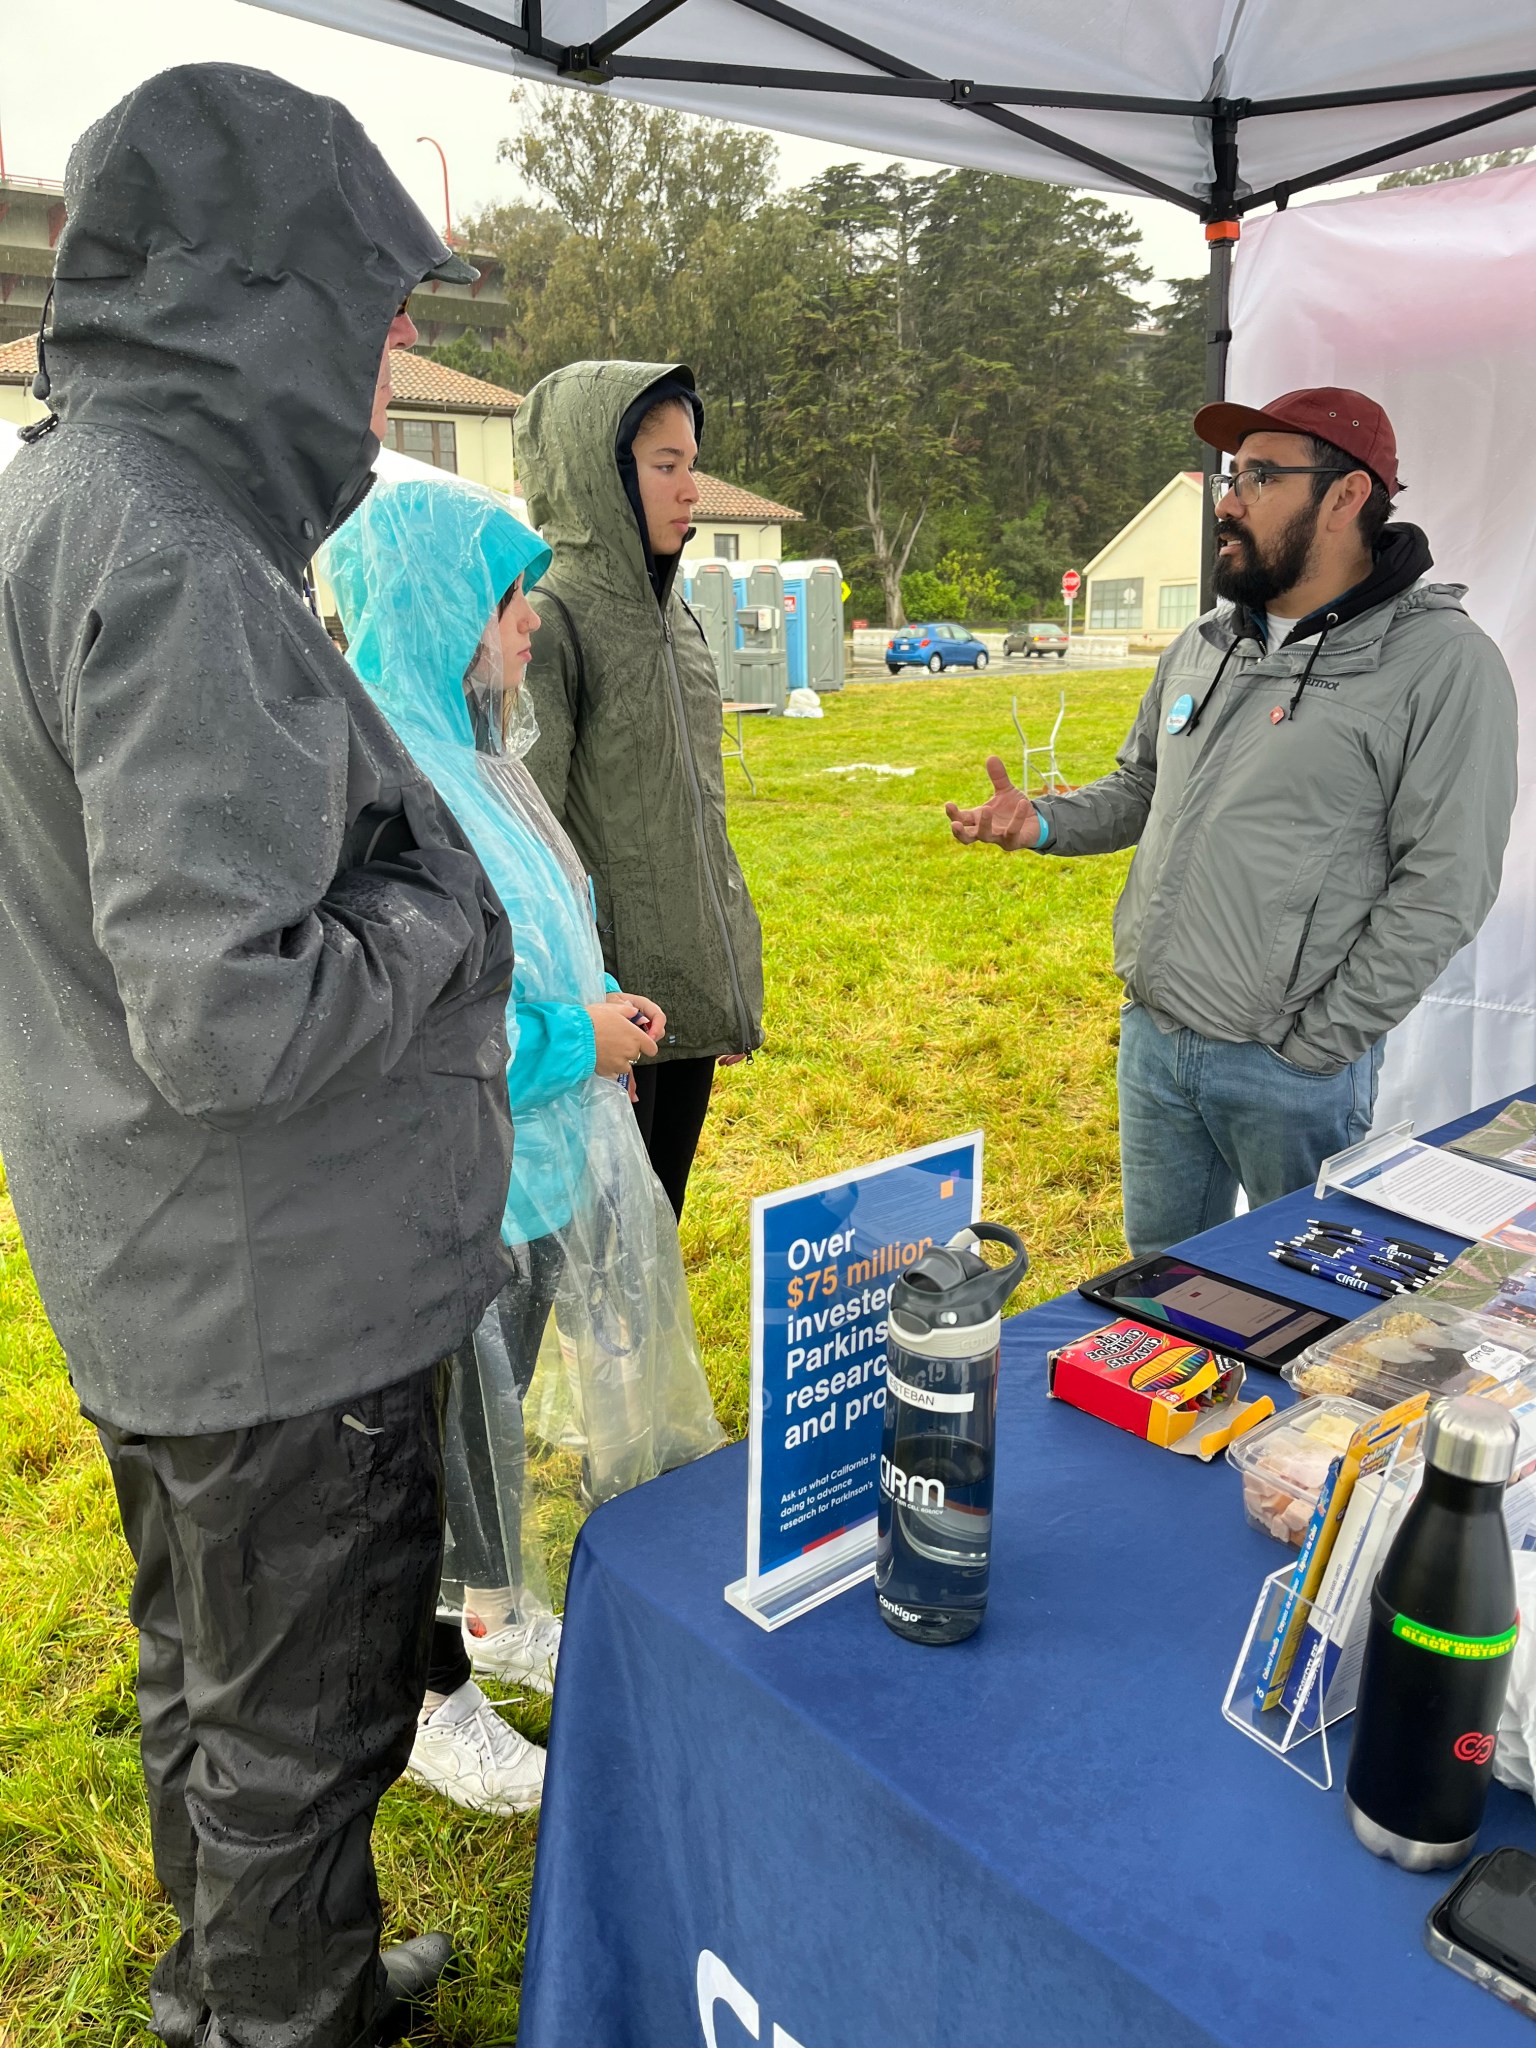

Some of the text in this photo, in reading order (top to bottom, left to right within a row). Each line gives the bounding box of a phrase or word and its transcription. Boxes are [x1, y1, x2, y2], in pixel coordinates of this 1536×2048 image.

[1062, 577, 1080, 586] STOP
[788, 1228, 855, 1270] Over
[787, 1237, 932, 1310] $75 million
[1335, 1272, 1368, 1291] CIRM
[1106, 1337, 1163, 1369] CRAYONS
[889, 1376, 935, 1406] ESTEBAN
[785, 1402, 836, 1450] and
[781, 1453, 876, 1504] Ask us what California is
[780, 1478, 853, 1518] doing to advance
[780, 1509, 816, 1532] research
[818, 1502, 829, 1513] for
[830, 1481, 873, 1507] Parkinson's
[879, 1594, 918, 1622] contigo
[1401, 1626, 1450, 1653] BLACK
[1454, 1641, 1511, 1658] HISTORY
